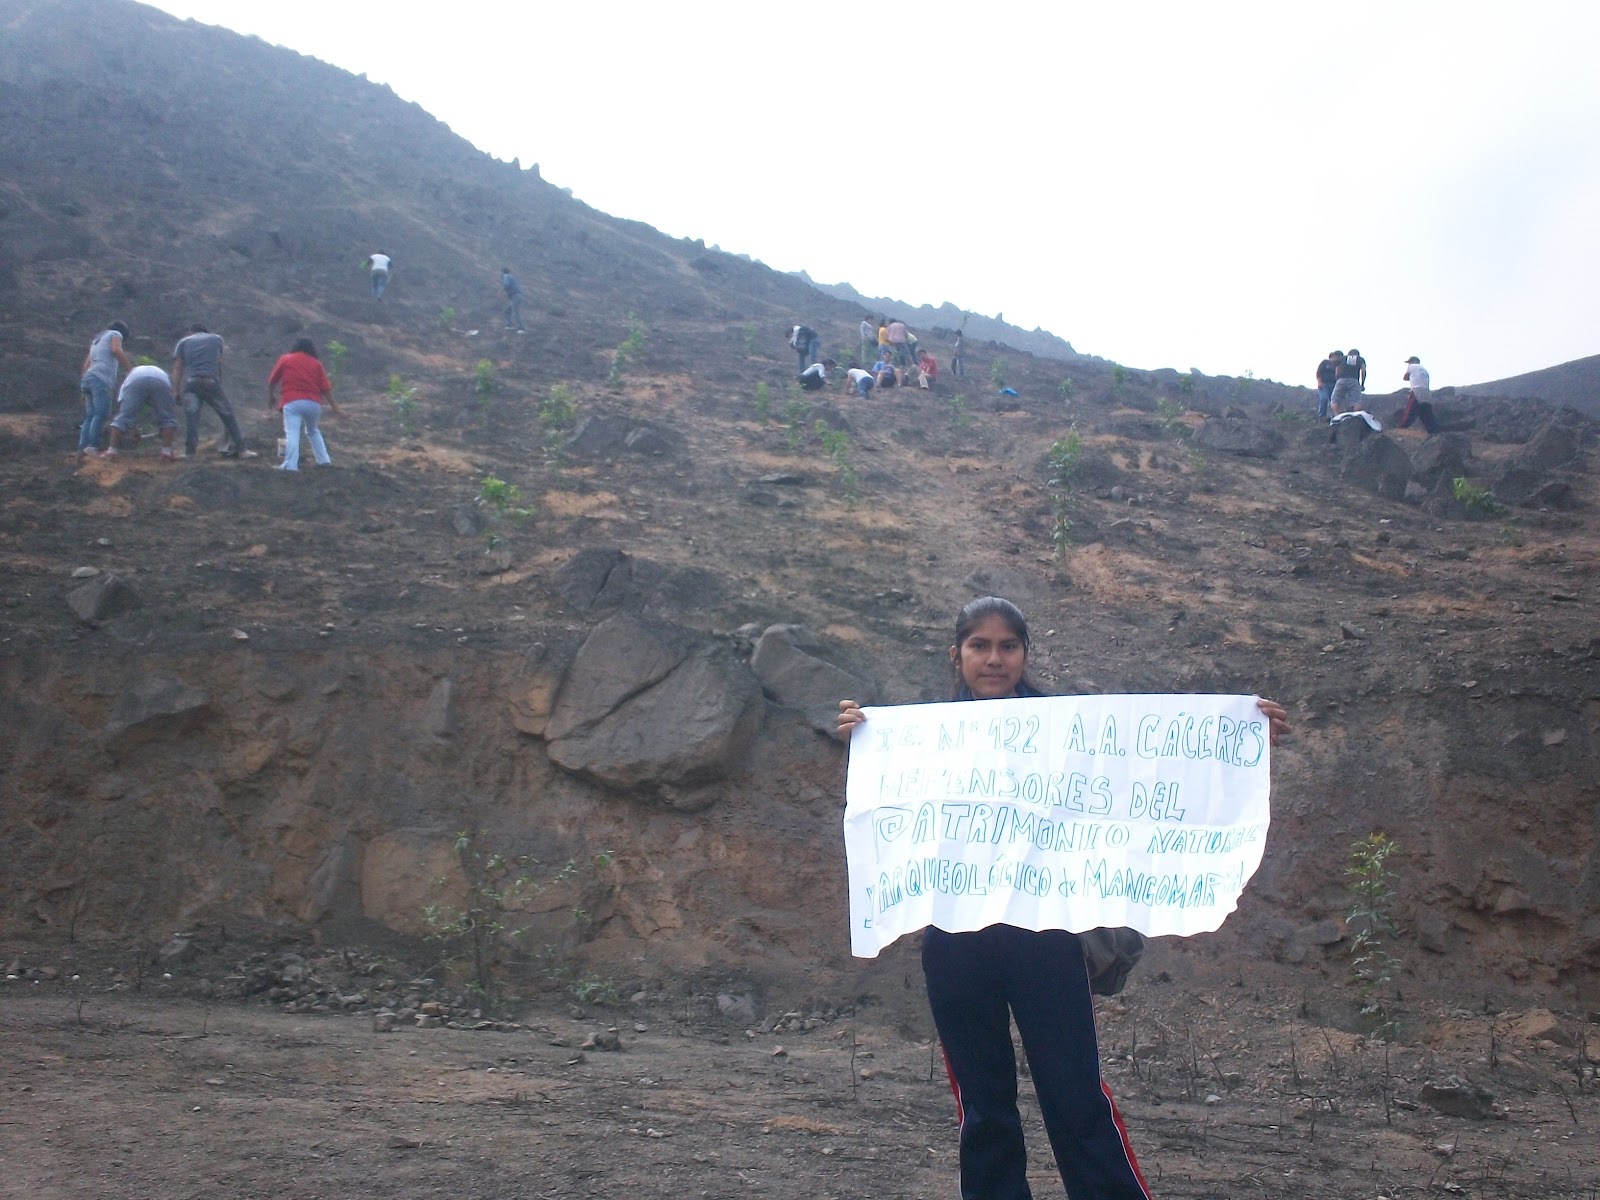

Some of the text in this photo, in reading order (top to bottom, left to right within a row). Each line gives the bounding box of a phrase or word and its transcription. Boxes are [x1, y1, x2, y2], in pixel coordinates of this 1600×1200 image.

[987, 713, 1040, 754] 122
[1063, 713, 1126, 758] A.A.
[1136, 711, 1265, 768] CÁCERES
[1130, 781, 1187, 823] DEL
[1147, 825, 1258, 854] NATURAL
[1058, 867, 1078, 898] de
